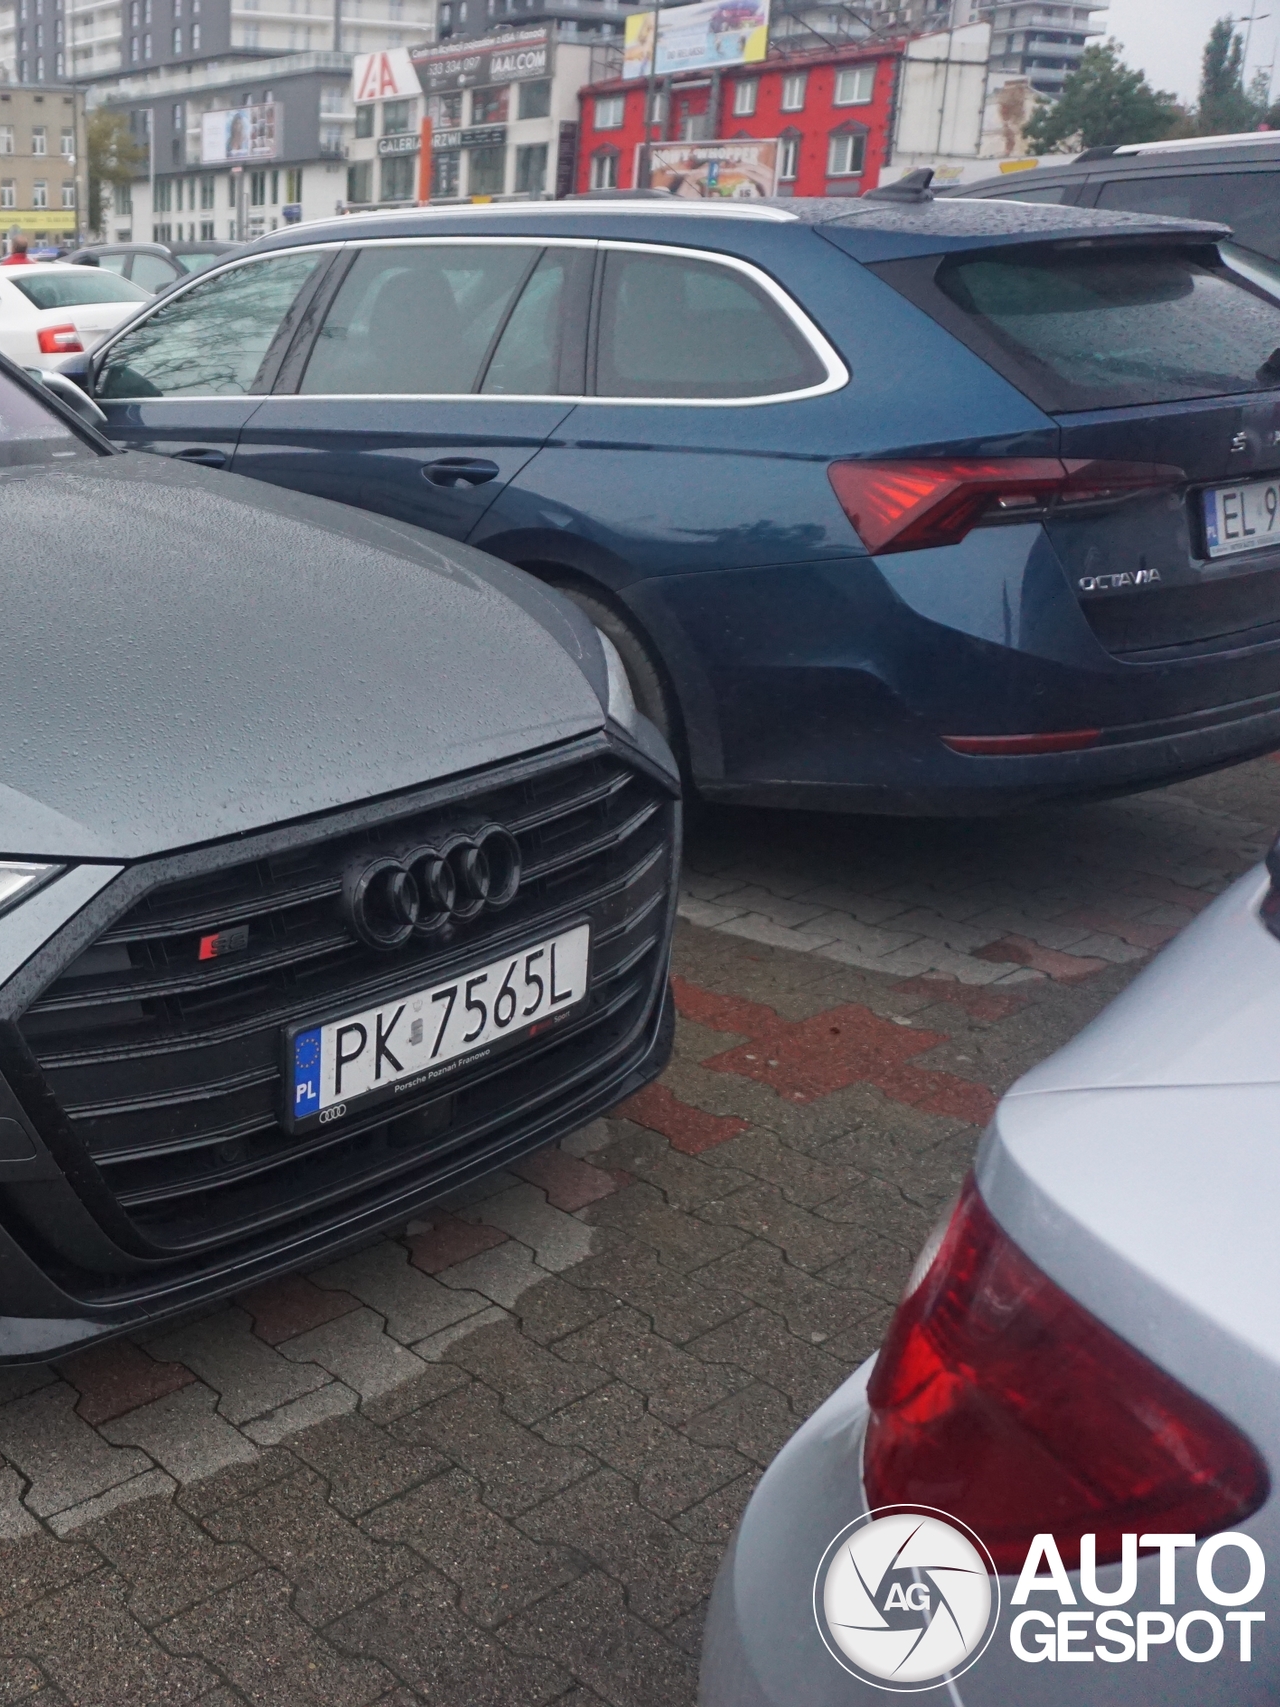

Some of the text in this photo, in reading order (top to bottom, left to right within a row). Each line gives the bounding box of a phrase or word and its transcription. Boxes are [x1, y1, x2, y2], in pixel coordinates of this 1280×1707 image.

[379, 134, 422, 152] GALERIA
[431, 131, 461, 147] RZWI
[1223, 484, 1280, 540] EL 9
[1078, 567, 1162, 591] OCTAVIA
[335, 942, 573, 1096] PK 7565L
[553, 1009, 571, 1025] Sport
[394, 1048, 491, 1093] Porsche Poznań Franowo
[295, 1080, 317, 1104] PL
